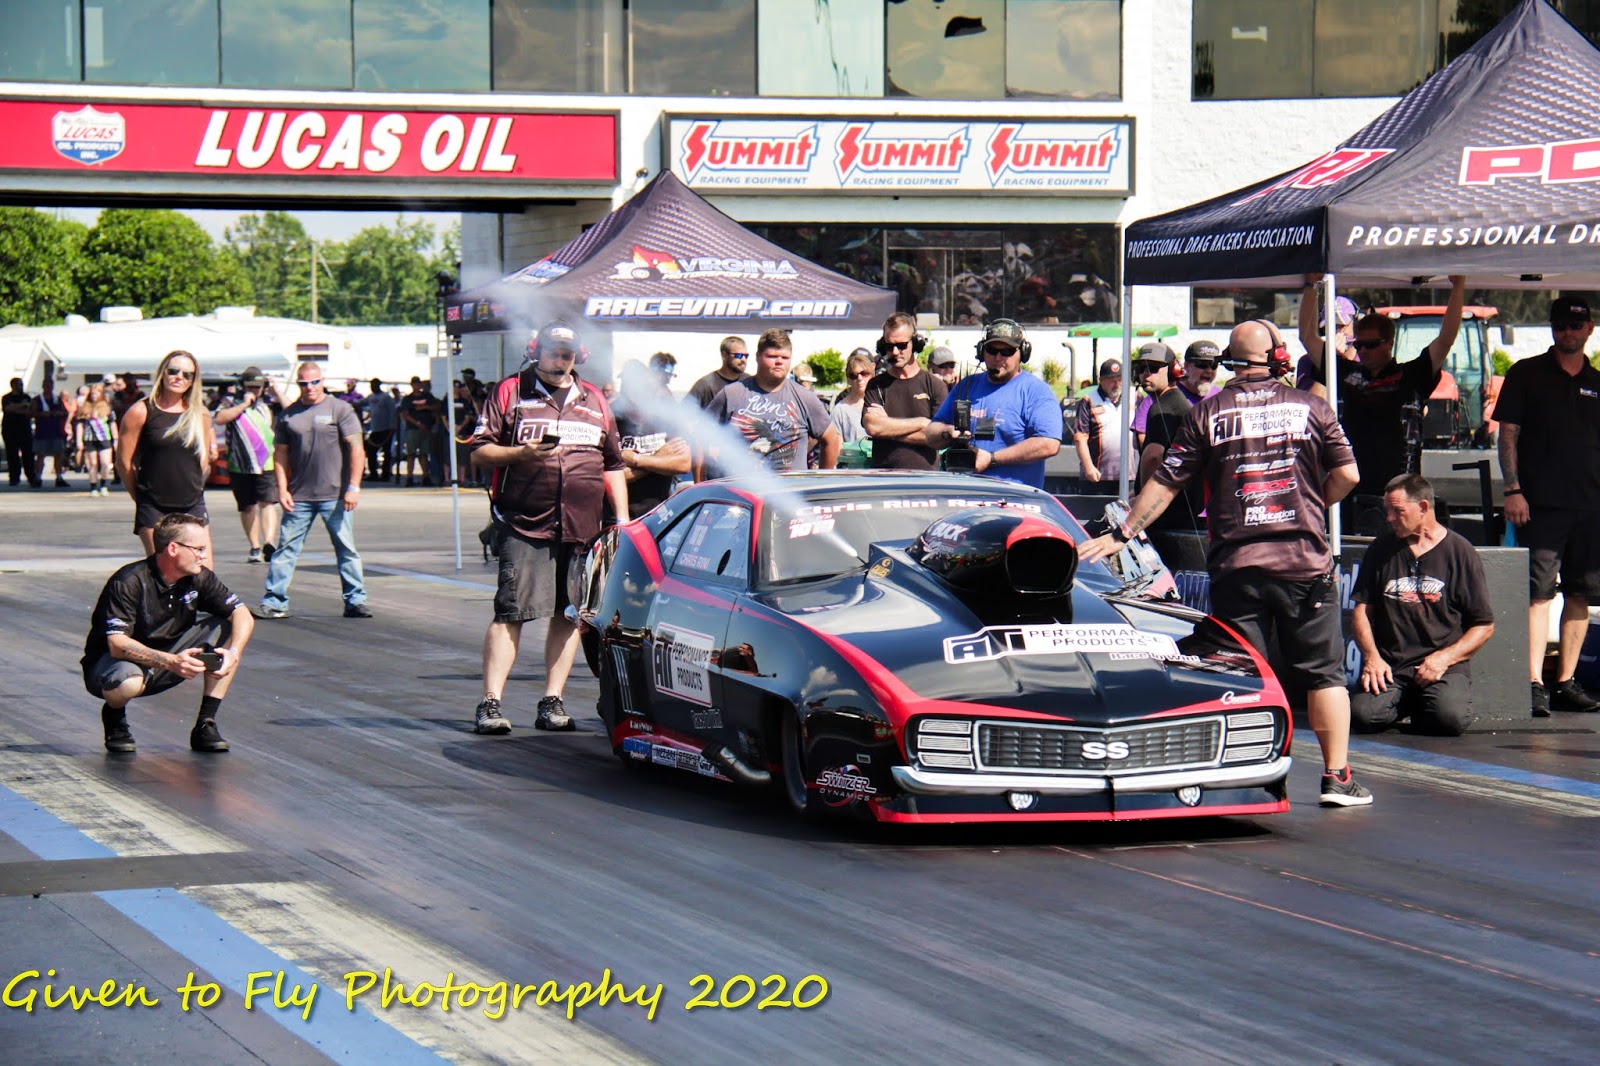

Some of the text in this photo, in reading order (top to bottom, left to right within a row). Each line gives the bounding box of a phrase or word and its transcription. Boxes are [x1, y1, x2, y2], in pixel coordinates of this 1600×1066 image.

[63, 127, 118, 139] LUCAS
[195, 110, 517, 172] LUCAS OIL
[700, 176, 808, 184] RACING EQUIPMENT
[852, 177, 959, 186] RACING EQUIPMENT
[1003, 177, 1109, 186] RACING EQUIPMENT
[1127, 225, 1315, 259] PROFESSIONAL DRAG RACERS ASSOCIATION
[1347, 225, 1557, 246] PROFESSIONAL
[678, 257, 798, 274] VIRGINIA
[662, 270, 760, 280] MOTORSPORTS
[1245, 408, 1304, 421] PERFORMANCE
[551, 424, 599, 437] PERFORMANCE
[930, 522, 970, 542] BUCK
[1029, 629, 1166, 644] PERFORMANCE
[1053, 637, 1147, 647] PRODUCTS
[677, 666, 703, 691] PRODUCTS
[1082, 741, 1131, 760] SS
[819, 787, 870, 802] DYNAMICS
